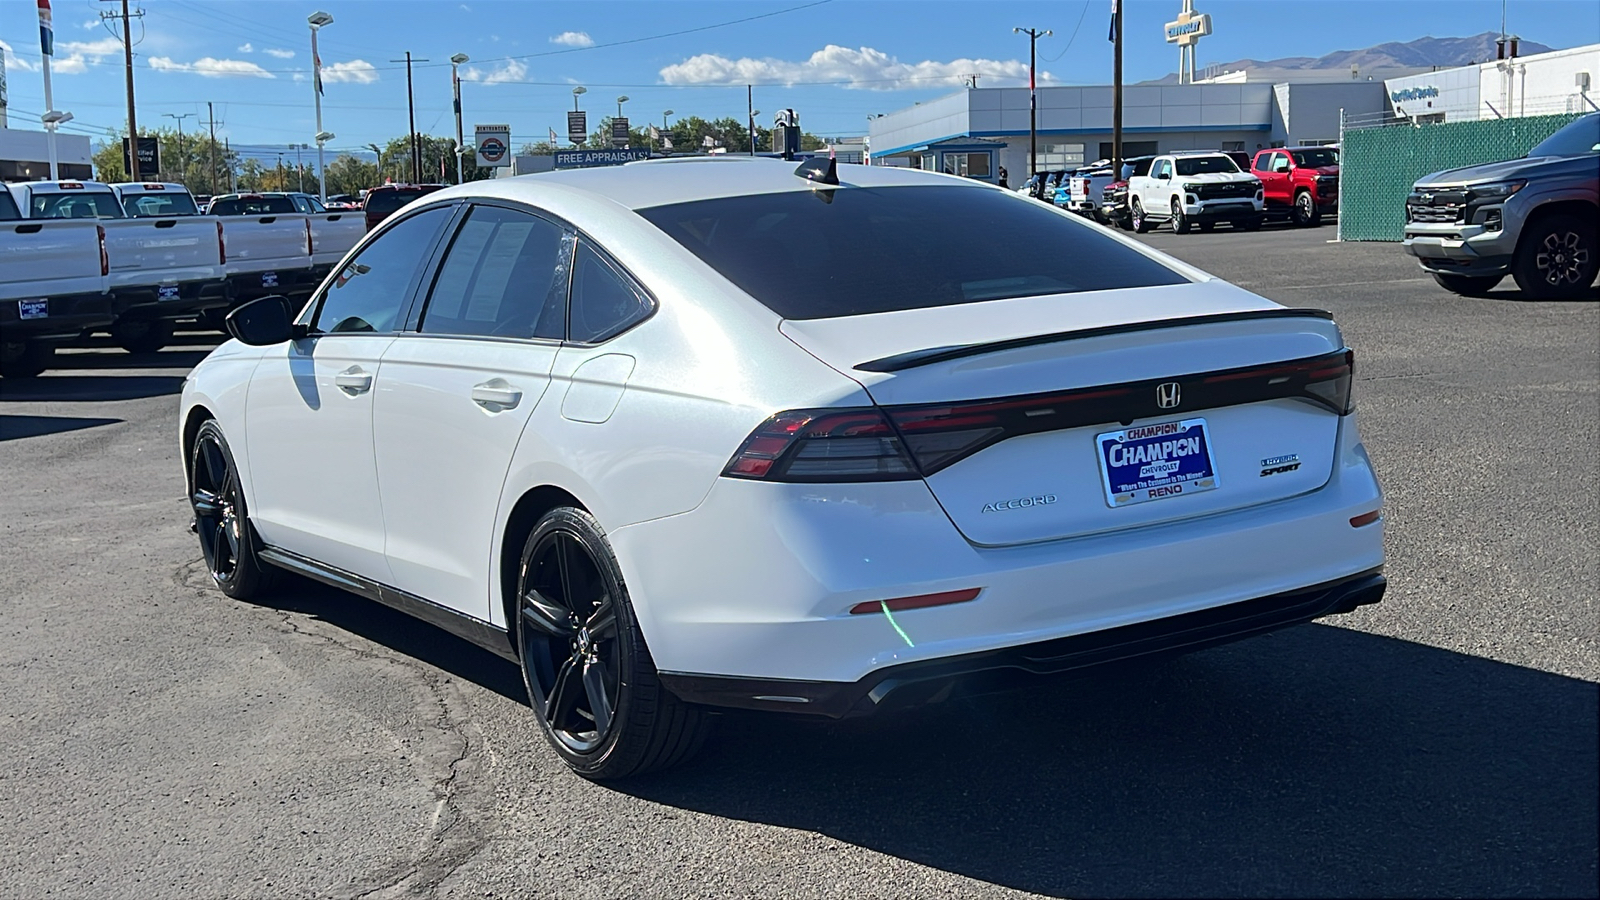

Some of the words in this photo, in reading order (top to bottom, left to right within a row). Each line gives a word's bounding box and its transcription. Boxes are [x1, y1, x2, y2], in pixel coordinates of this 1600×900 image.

[557, 153, 584, 164] FREE
[1128, 423, 1178, 440] CHAMPION
[1109, 437, 1200, 468] CHAMPION
[1141, 463, 1178, 475] CHEVROLET
[1260, 462, 1301, 477] SPORT
[1148, 484, 1183, 498] RENO
[981, 494, 1058, 513] ACCORD
